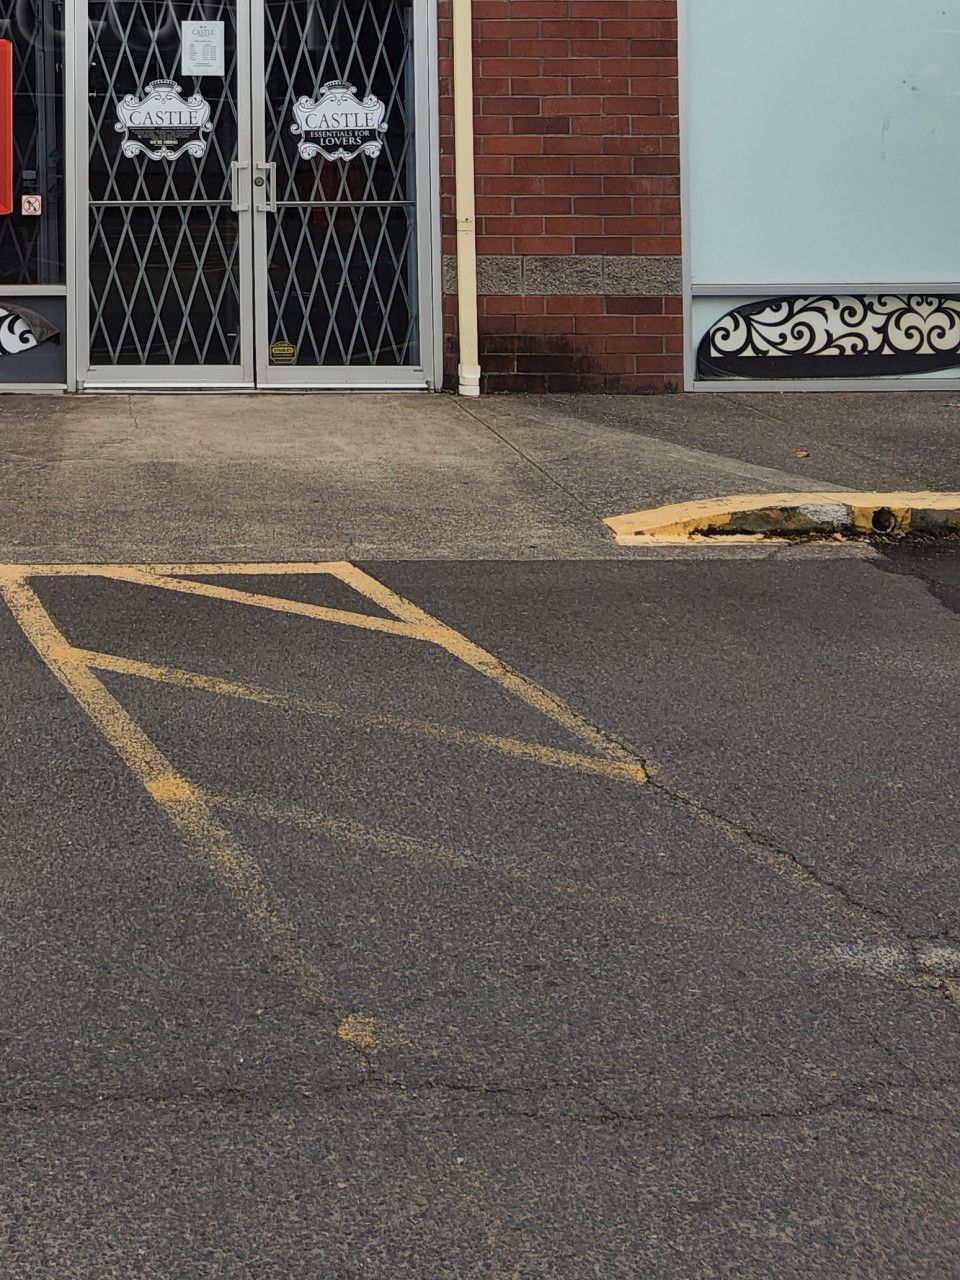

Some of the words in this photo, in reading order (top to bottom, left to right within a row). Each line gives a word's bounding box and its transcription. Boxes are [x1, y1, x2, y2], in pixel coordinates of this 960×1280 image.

[129, 110, 198, 125] CASTLE
[305, 112, 375, 128] CASTLE
[320, 137, 362, 146] LOVERS
